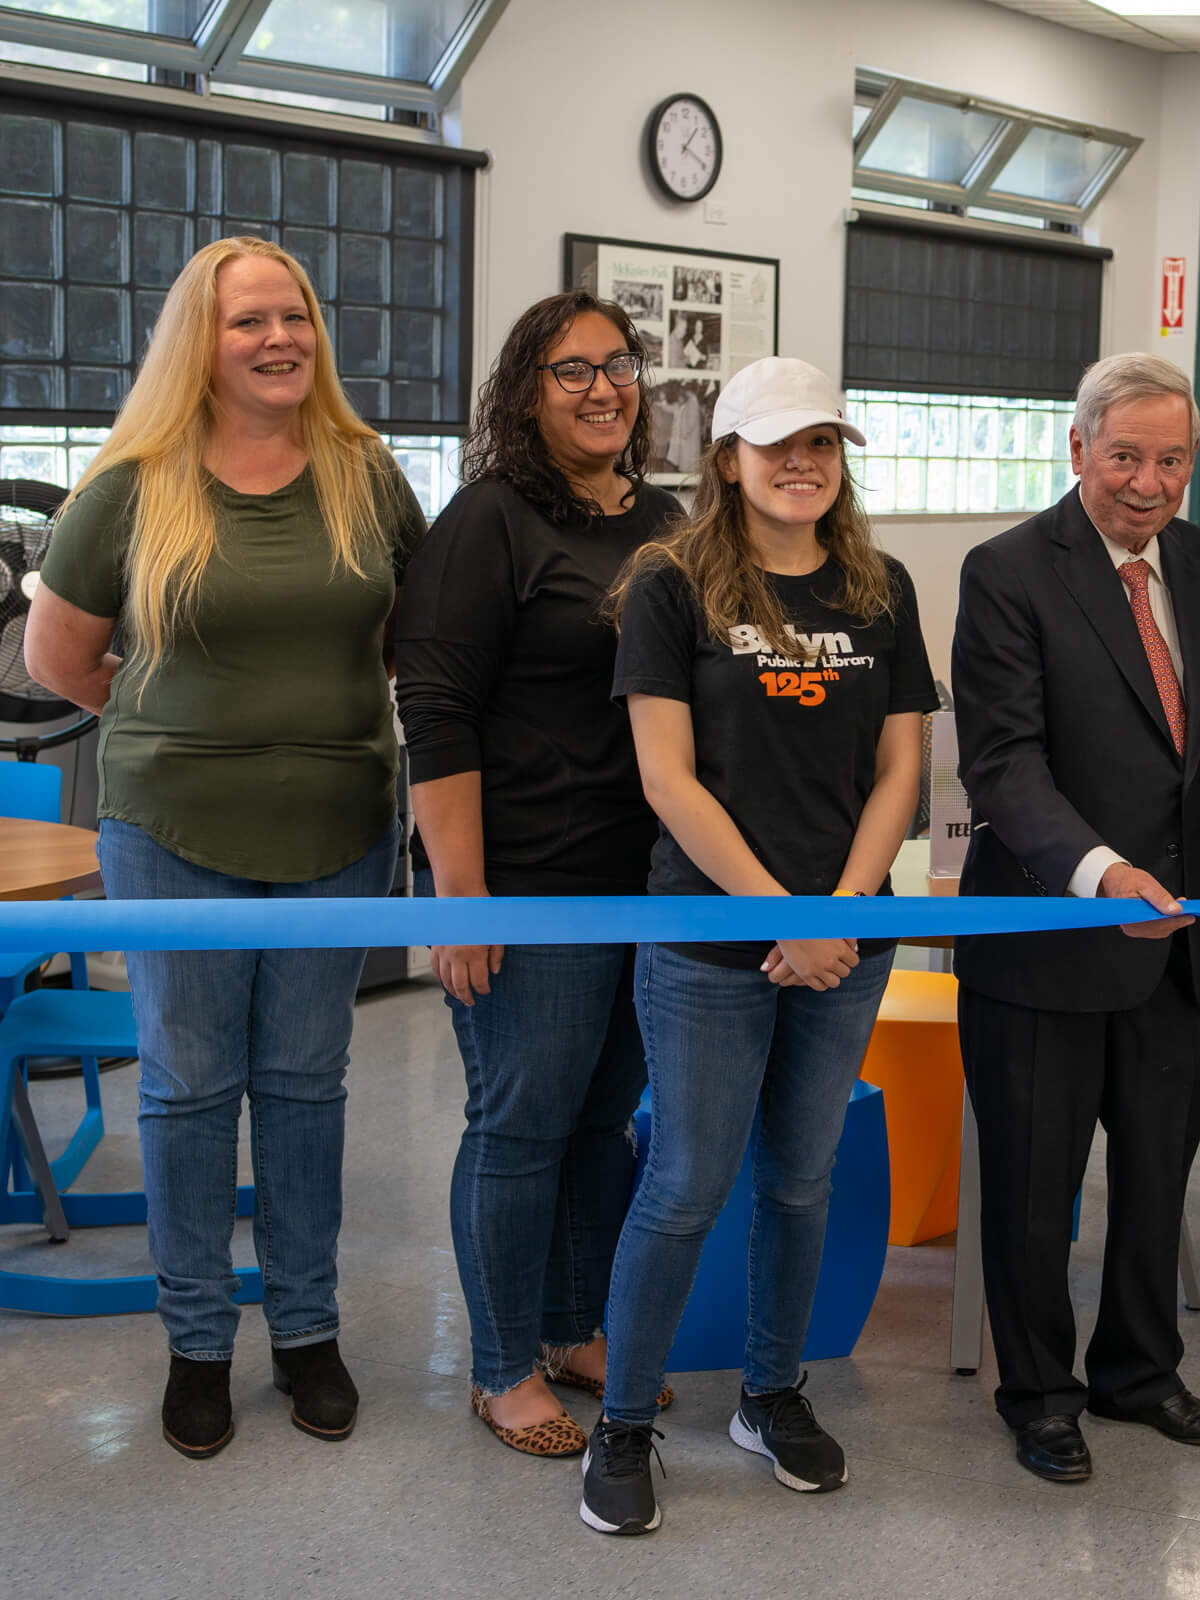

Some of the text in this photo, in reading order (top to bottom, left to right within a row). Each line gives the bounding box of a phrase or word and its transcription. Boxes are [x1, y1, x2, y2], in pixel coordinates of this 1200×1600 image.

[757, 654, 874, 669] Public Library
[758, 668, 840, 707] 125th
